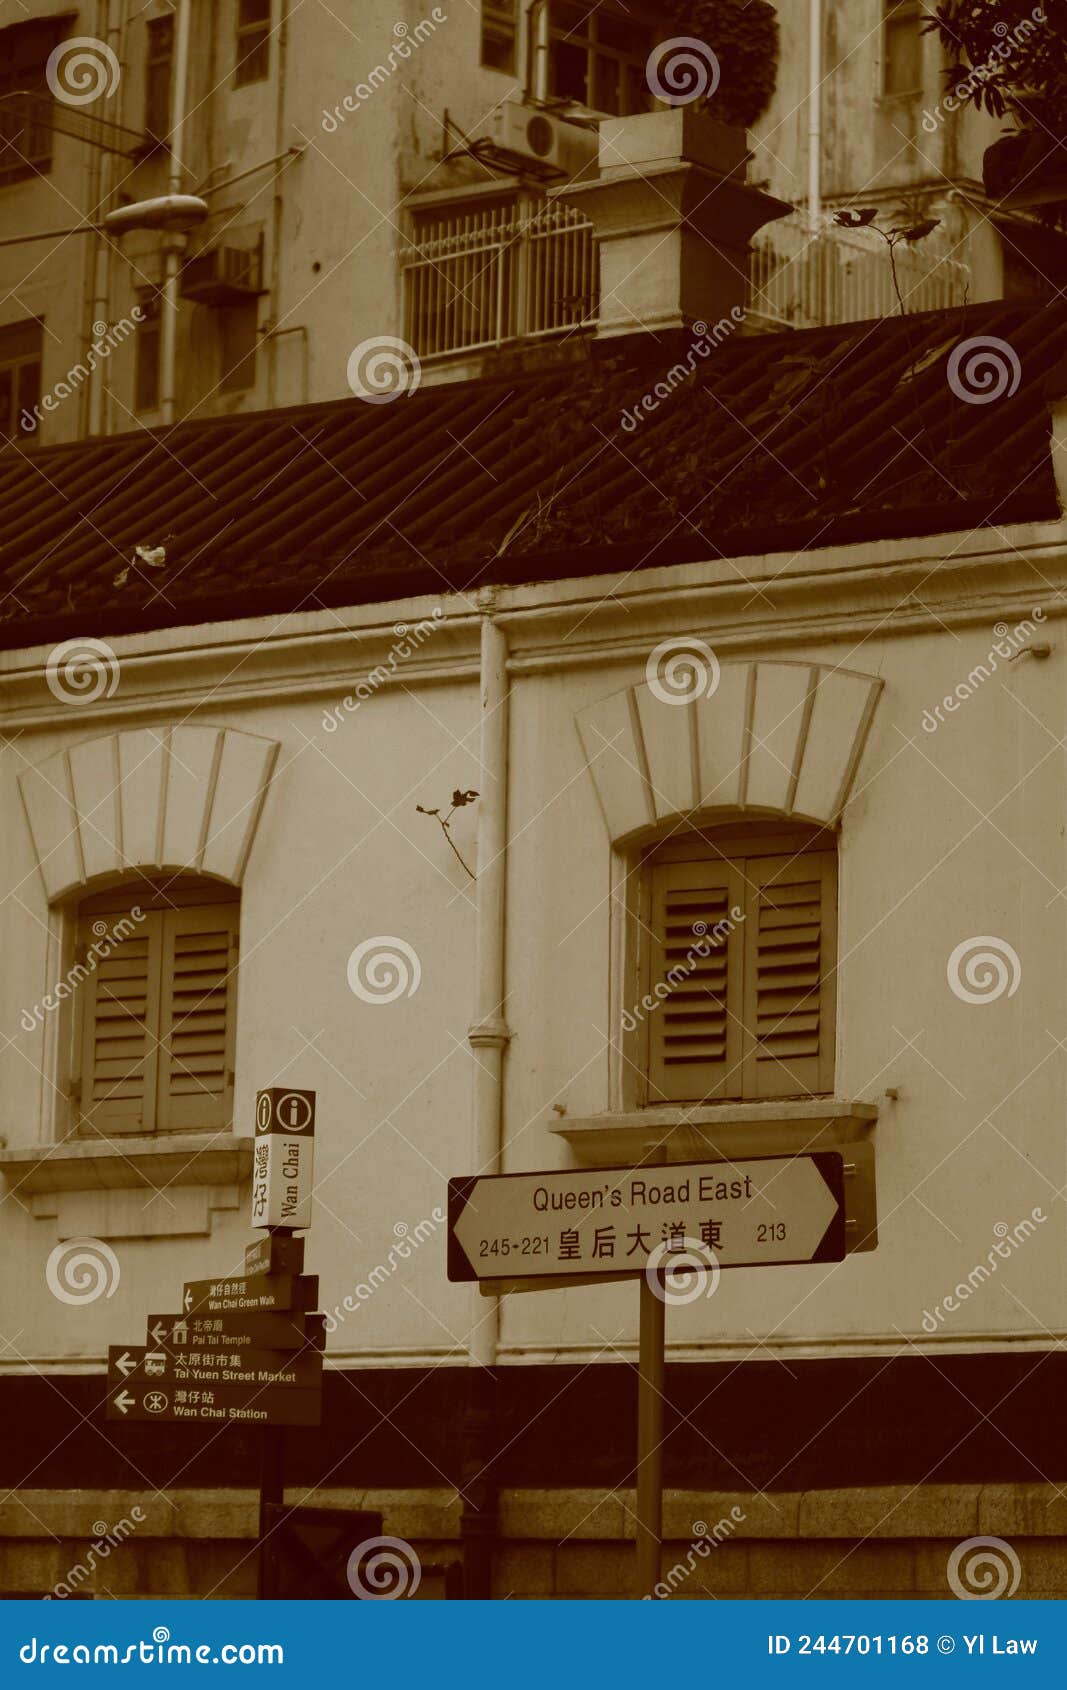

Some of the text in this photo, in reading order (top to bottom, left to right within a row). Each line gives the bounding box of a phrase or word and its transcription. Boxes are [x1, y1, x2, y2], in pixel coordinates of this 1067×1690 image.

[281, 1143, 300, 1218] Wan Chai
[533, 1175, 752, 1212] Queen's Road East
[558, 1219, 724, 1261] 皇后大道東
[756, 1223, 787, 1242] 213
[479, 1236, 550, 1257] 245-221
[208, 1295, 275, 1311] Wan Chai Green Walk
[192, 1335, 251, 1347] Pai Tai Temple
[174, 1352, 241, 1368] 太原街市集
[174, 1368, 296, 1383] Tai Yuen Street Market
[174, 1390, 214, 1405] 灣仔站
[173, 1406, 268, 1420] Wan Chai Station
